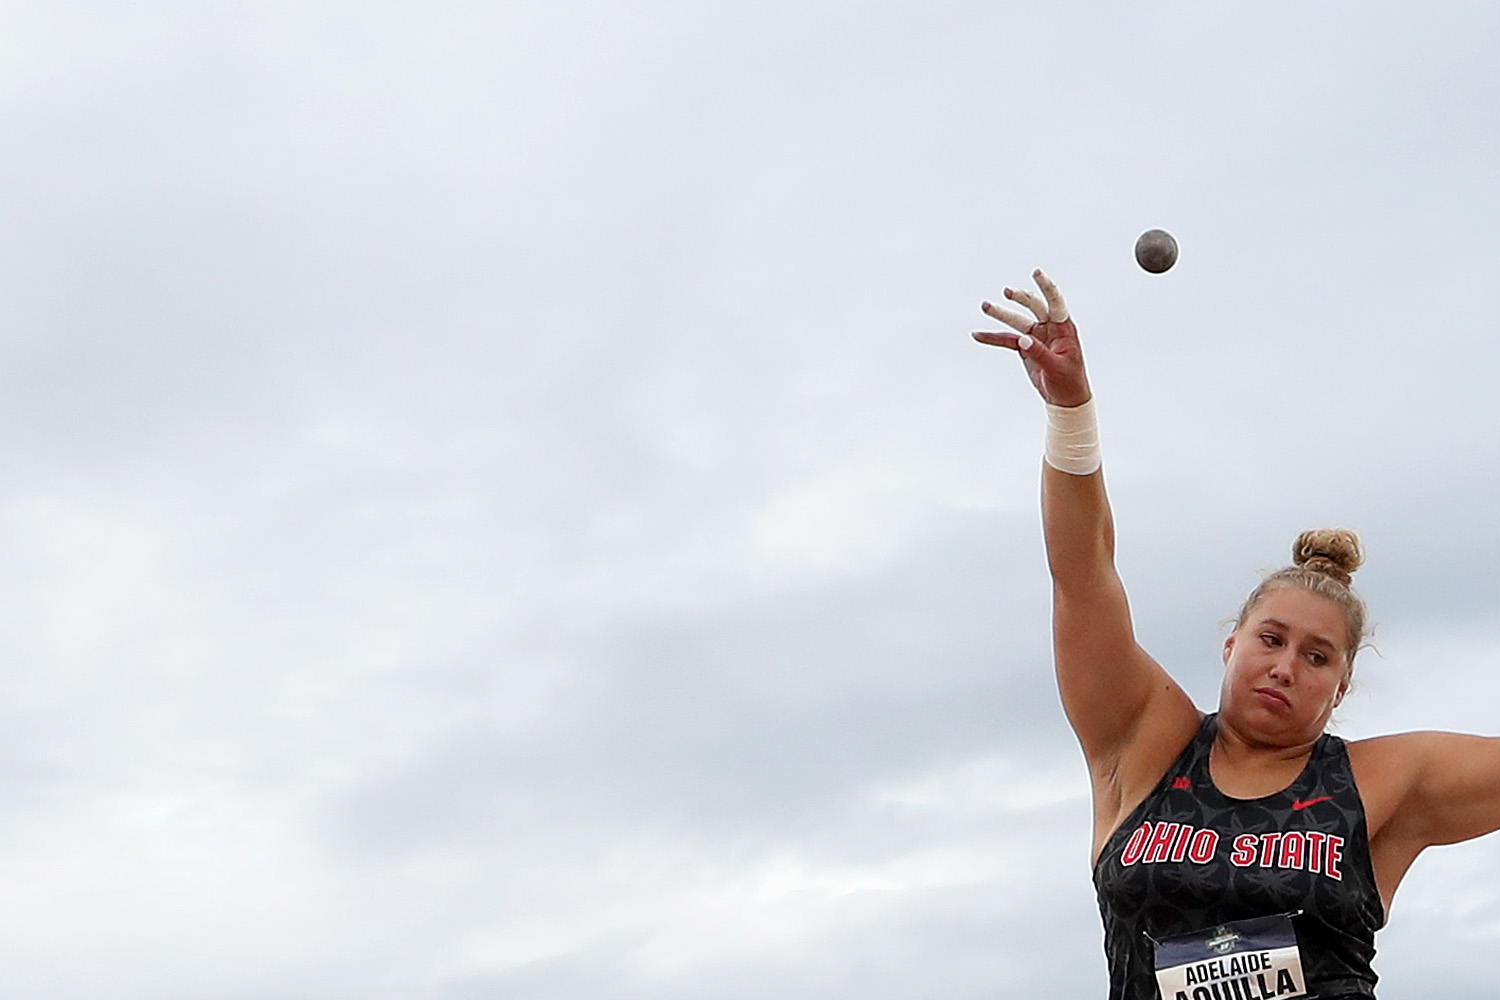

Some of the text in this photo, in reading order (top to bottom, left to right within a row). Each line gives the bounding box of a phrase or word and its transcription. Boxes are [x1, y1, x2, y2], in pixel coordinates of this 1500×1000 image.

[1121, 821, 1344, 881] OHIO STATE
[1186, 952, 1272, 986] ADELAIDE
